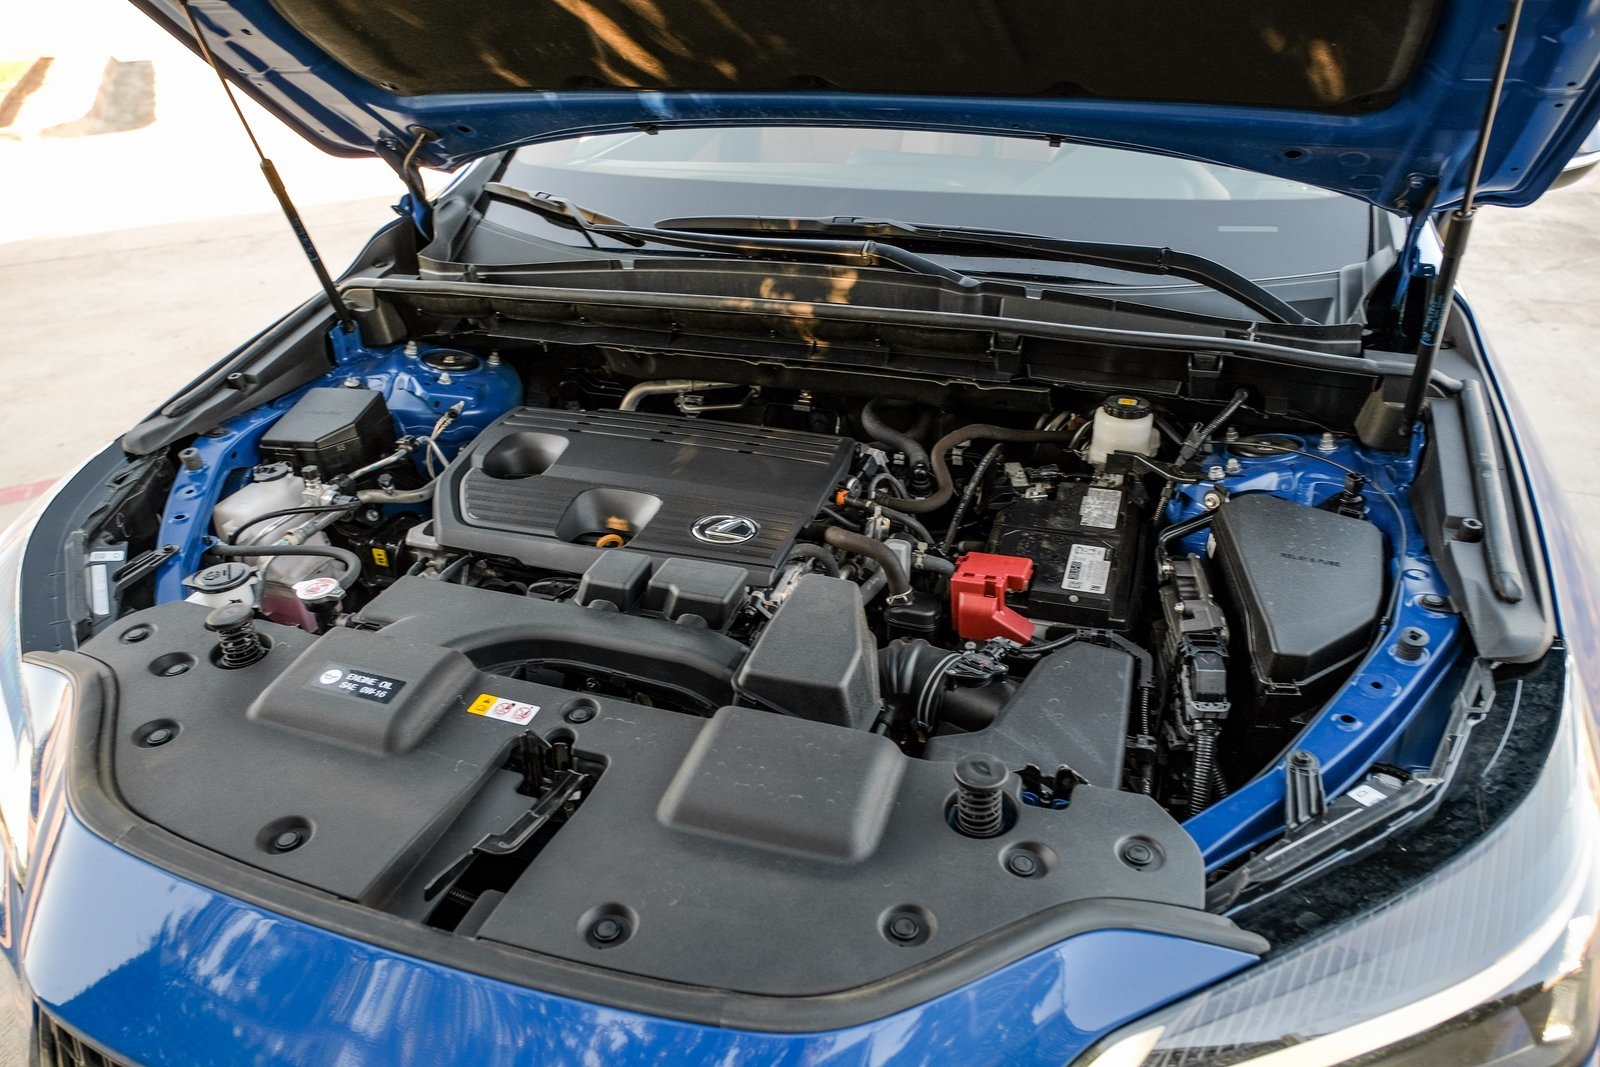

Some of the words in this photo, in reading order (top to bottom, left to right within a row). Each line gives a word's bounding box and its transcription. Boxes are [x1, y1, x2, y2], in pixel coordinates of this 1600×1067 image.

[338, 681, 359, 691] SAE
[345, 673, 379, 686] ENGINE
[378, 681, 394, 690] OIL
